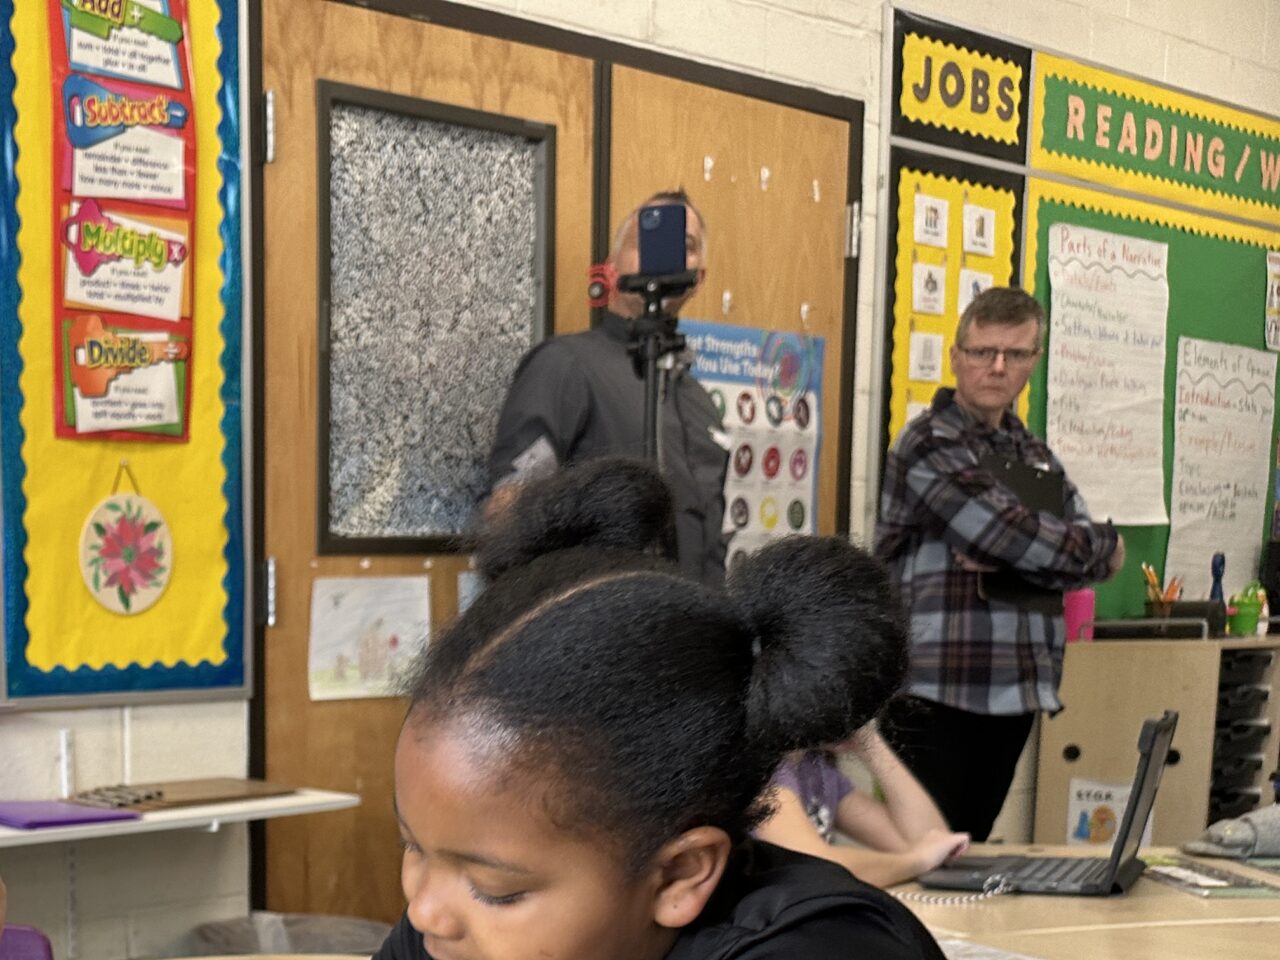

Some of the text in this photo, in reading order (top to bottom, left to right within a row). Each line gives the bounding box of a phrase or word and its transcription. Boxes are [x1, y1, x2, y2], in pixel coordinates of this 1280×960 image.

[912, 55, 1014, 122] JOBS
[86, 95, 169, 127] Subtract
[82, 221, 167, 272] Multiply
[86, 338, 152, 368] Divide
